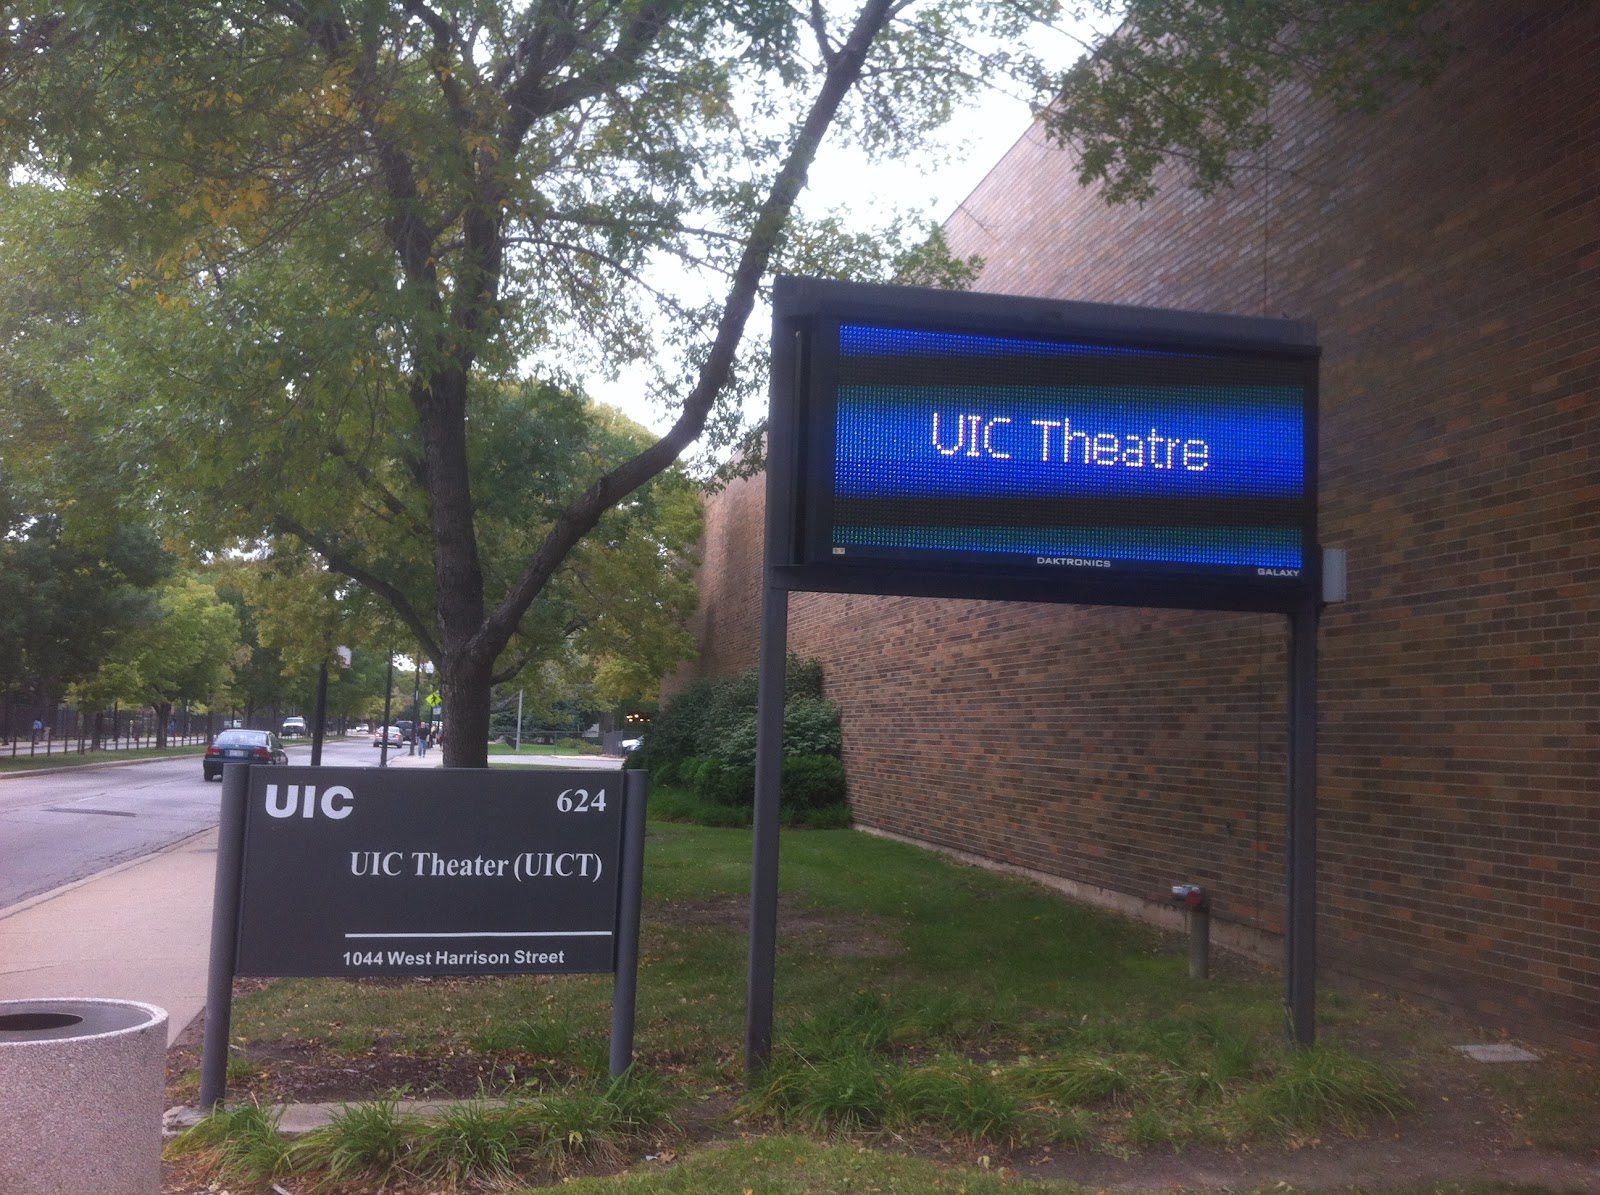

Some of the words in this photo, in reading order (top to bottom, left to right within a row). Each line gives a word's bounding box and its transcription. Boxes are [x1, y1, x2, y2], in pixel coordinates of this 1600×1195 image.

[932, 412, 1011, 459] UIC
[1031, 417, 1210, 471] Theatre
[1036, 556, 1111, 568] DAKTRONICS
[1257, 567, 1300, 577] GALAXY
[265, 784, 354, 820] UIC
[556, 788, 607, 813] 624
[350, 851, 403, 877] UIC
[411, 851, 509, 877] Theater
[513, 852, 603, 883] (UICT)
[343, 950, 384, 966] 1044
[387, 950, 432, 966] West
[435, 949, 510, 966] Harrison
[514, 949, 565, 965] Street
